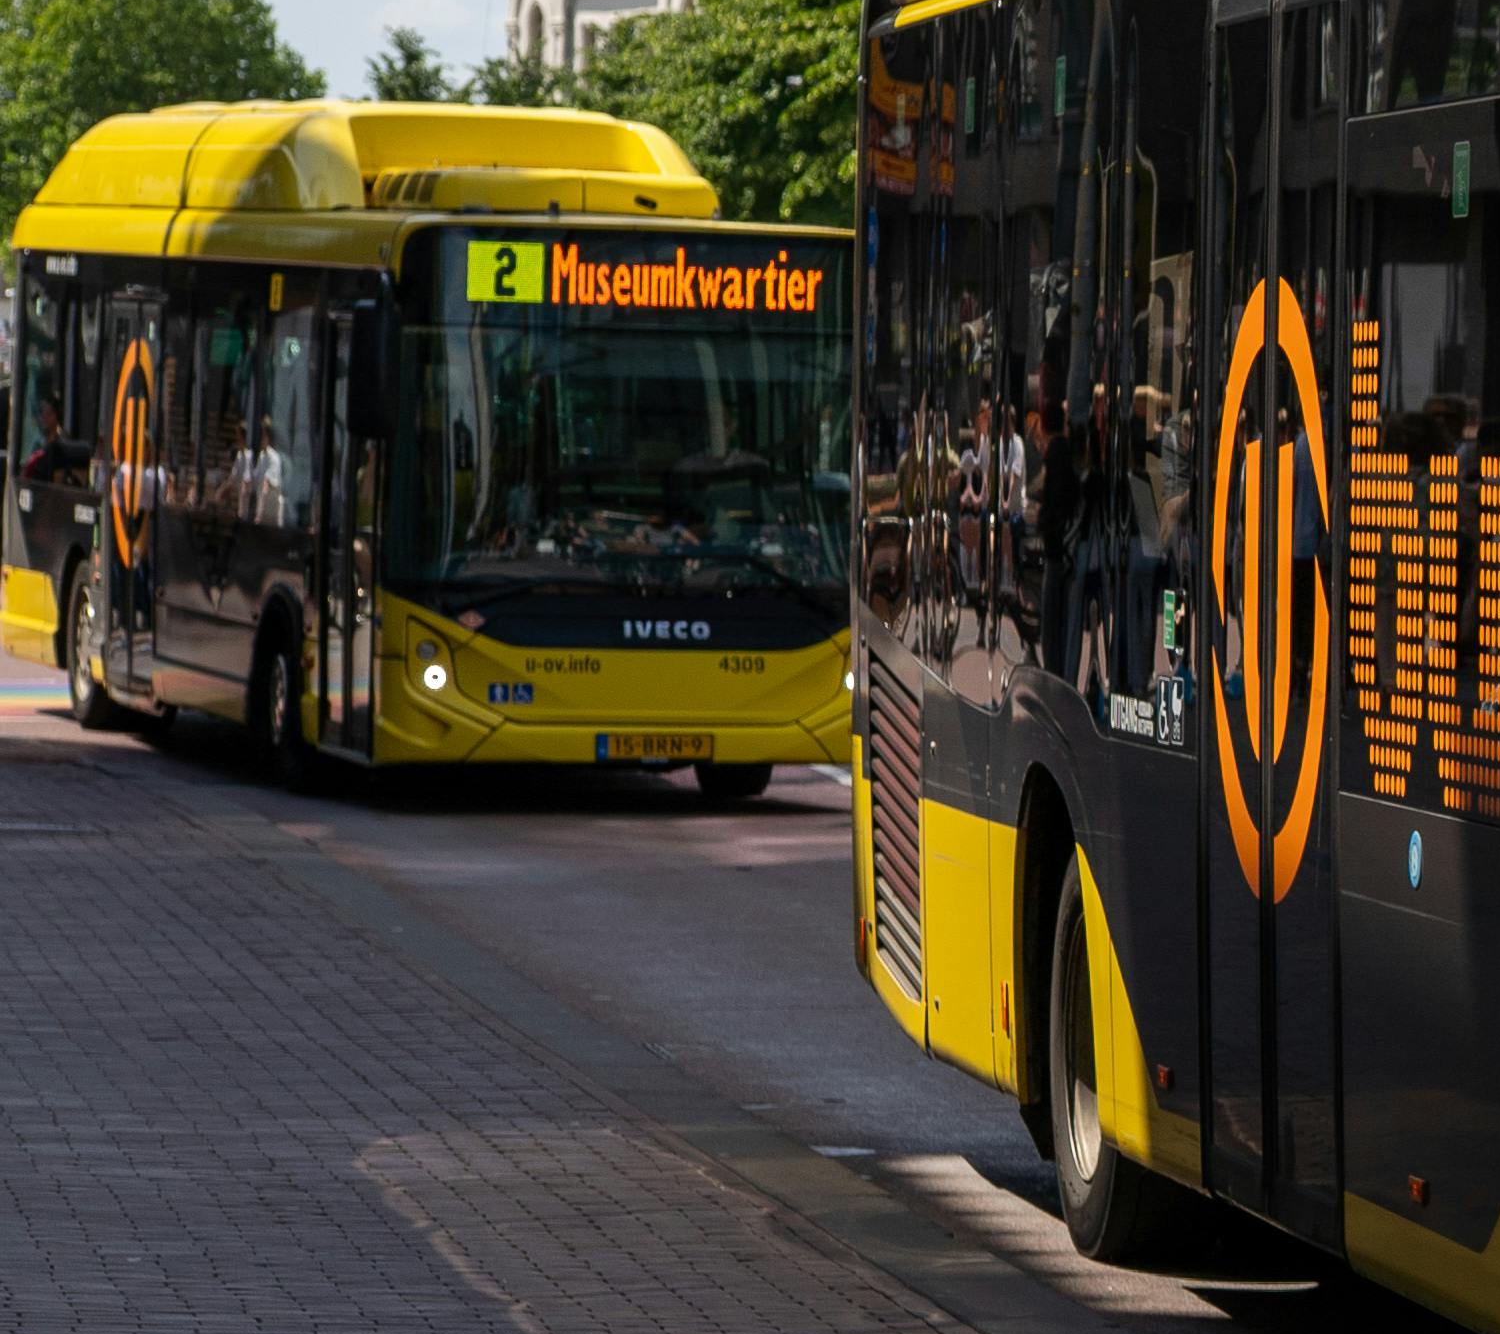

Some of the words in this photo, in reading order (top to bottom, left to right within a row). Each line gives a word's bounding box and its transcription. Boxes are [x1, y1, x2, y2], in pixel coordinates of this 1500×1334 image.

[493, 246, 517, 297] 2
[551, 242, 823, 312] Museumkwartier
[623, 620, 711, 640] IVECO
[525, 655, 602, 675] u-ov.info
[718, 655, 765, 674] 4309
[614, 735, 704, 756] 15-BRN-9
